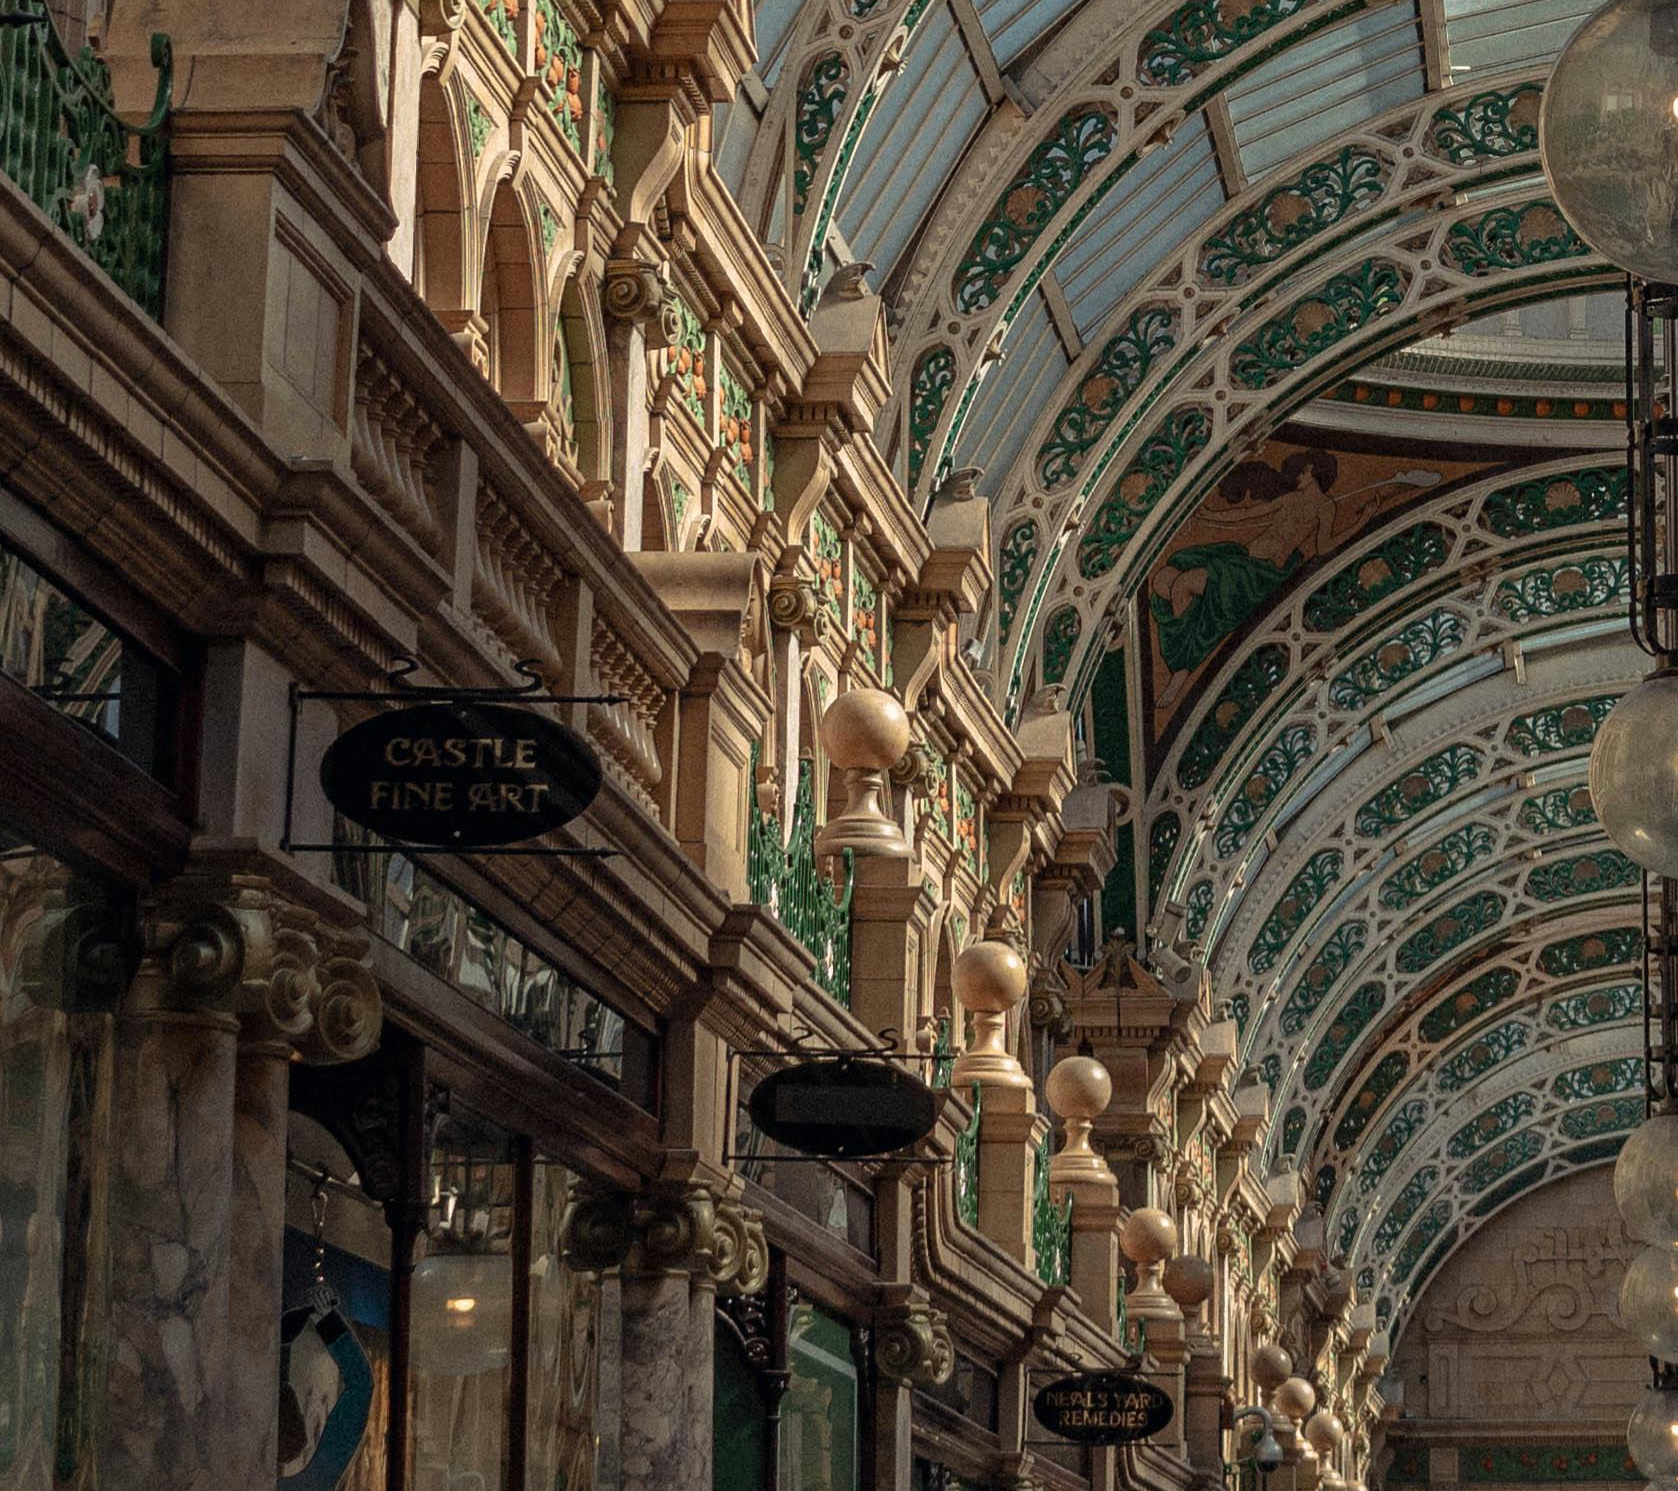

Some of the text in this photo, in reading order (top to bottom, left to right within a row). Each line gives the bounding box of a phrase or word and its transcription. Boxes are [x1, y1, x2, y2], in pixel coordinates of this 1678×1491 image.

[384, 736, 537, 768] CASTLE
[368, 780, 551, 813] FINE ART
[1114, 1392, 1164, 1409] YARD
[1058, 1410, 1149, 1428] REMEDIES
